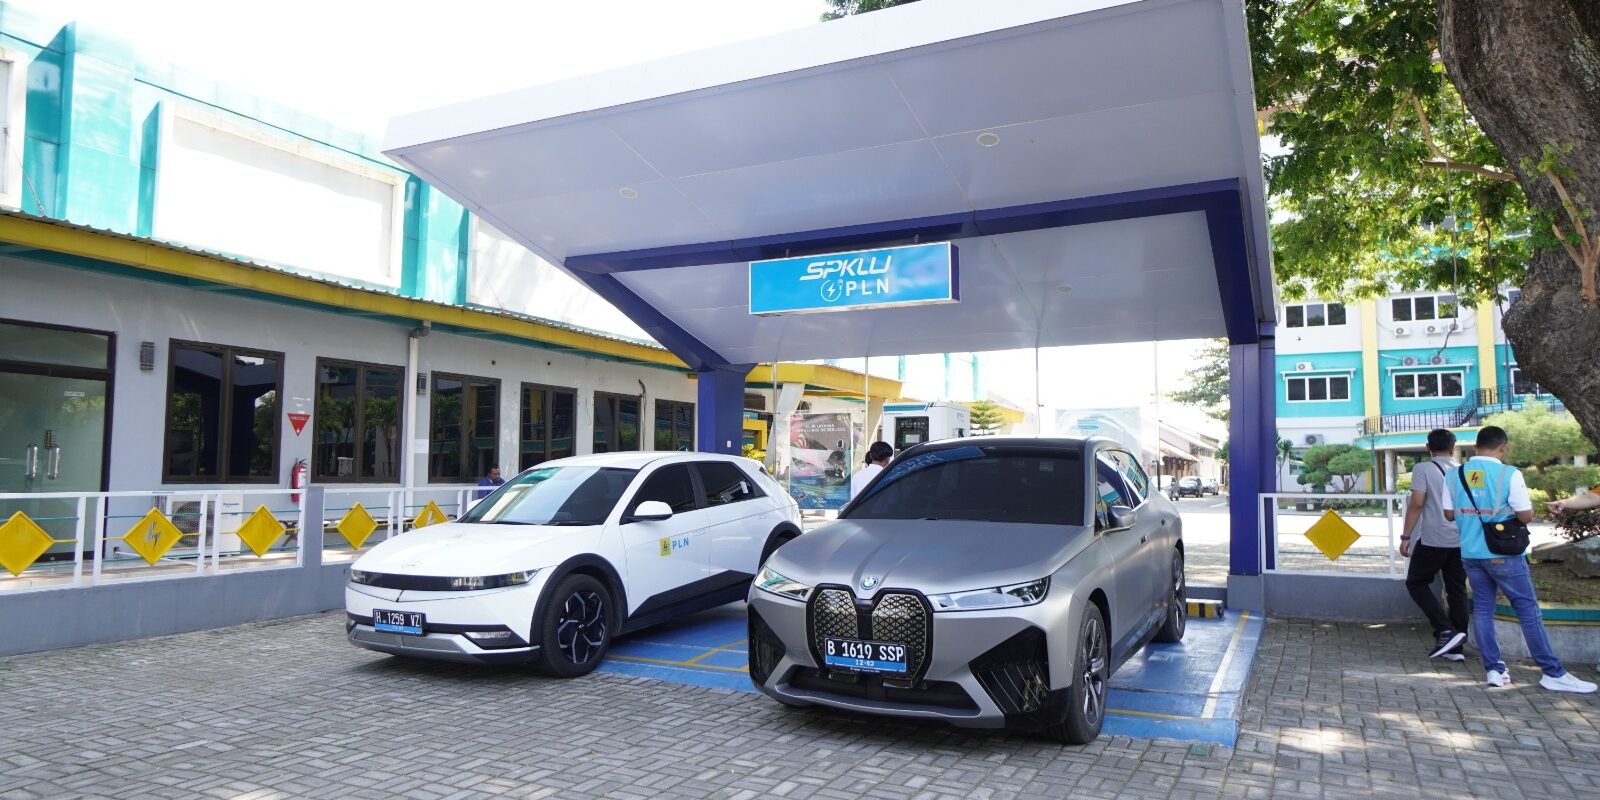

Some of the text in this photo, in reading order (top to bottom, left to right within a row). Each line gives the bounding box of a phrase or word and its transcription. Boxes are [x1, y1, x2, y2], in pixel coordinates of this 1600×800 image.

[800, 255, 892, 280] SPKLU
[846, 278, 889, 296] PLN
[672, 537, 689, 549] PLN
[376, 612, 420, 627] H 1259 VZ
[827, 640, 903, 662] B 1619 SSP
